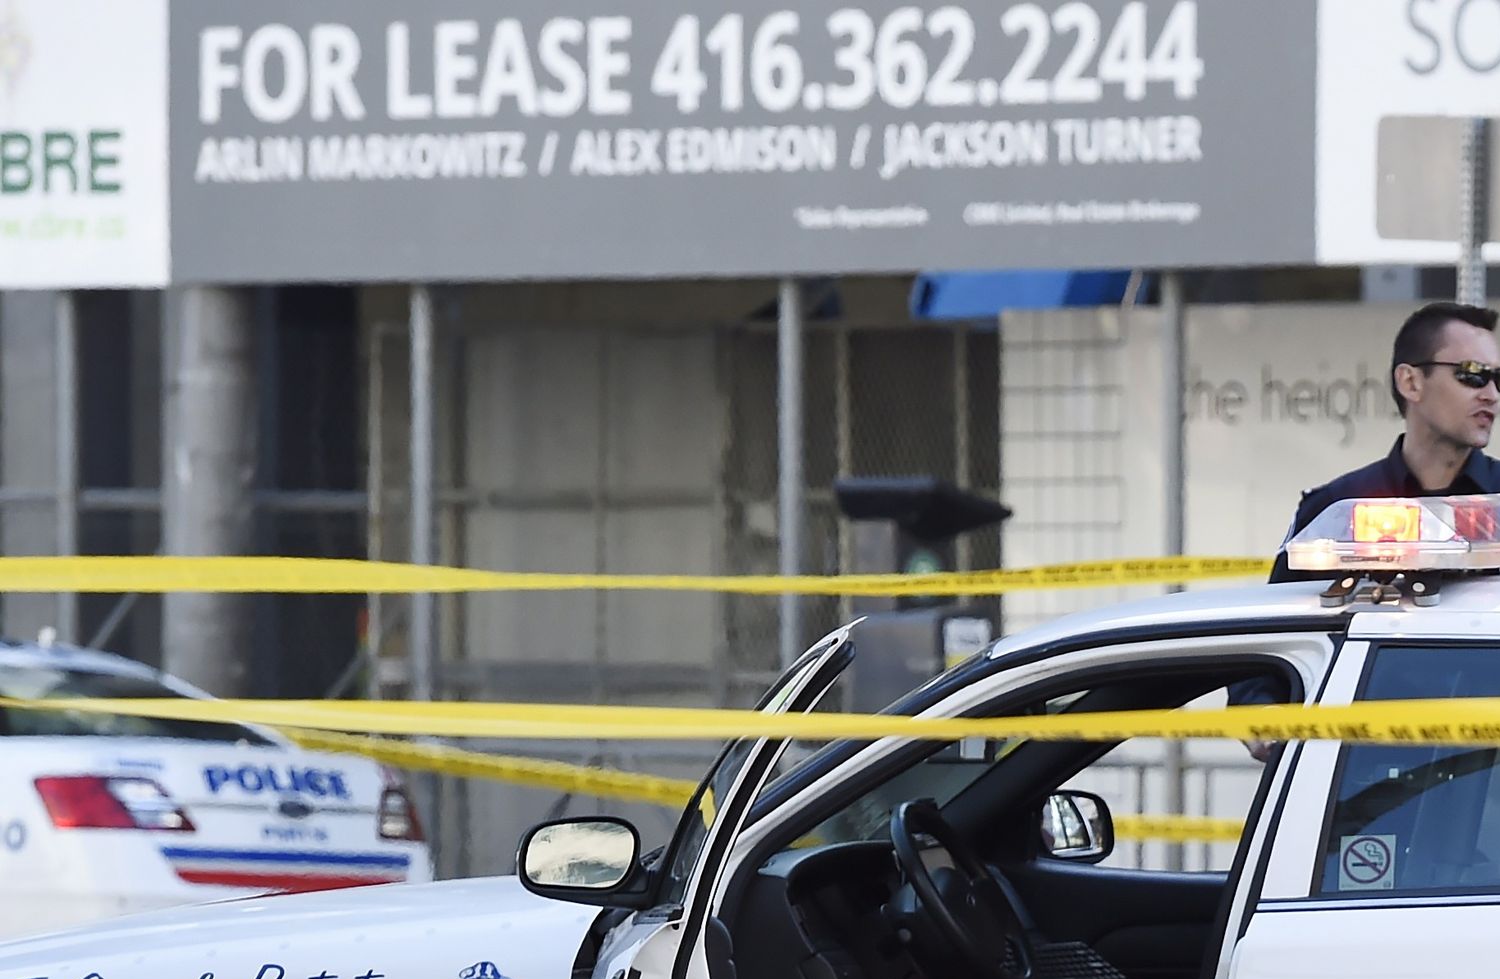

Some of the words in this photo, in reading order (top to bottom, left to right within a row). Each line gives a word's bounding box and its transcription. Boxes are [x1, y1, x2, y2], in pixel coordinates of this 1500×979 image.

[200, 24, 366, 123] FOR
[386, 16, 633, 119] LEASE
[651, 0, 1204, 112] 416.362.2244
[196, 137, 300, 184] ARLIN
[309, 131, 527, 181] MARKOWITZ
[570, 129, 662, 175] ALEX
[667, 126, 837, 174] EDMISON
[880, 120, 1048, 179] JACKSON
[1055, 116, 1203, 166] TURNER
[1186, 363, 1249, 425] he
[1261, 359, 1397, 447] heigh
[203, 763, 352, 799] POLICE
